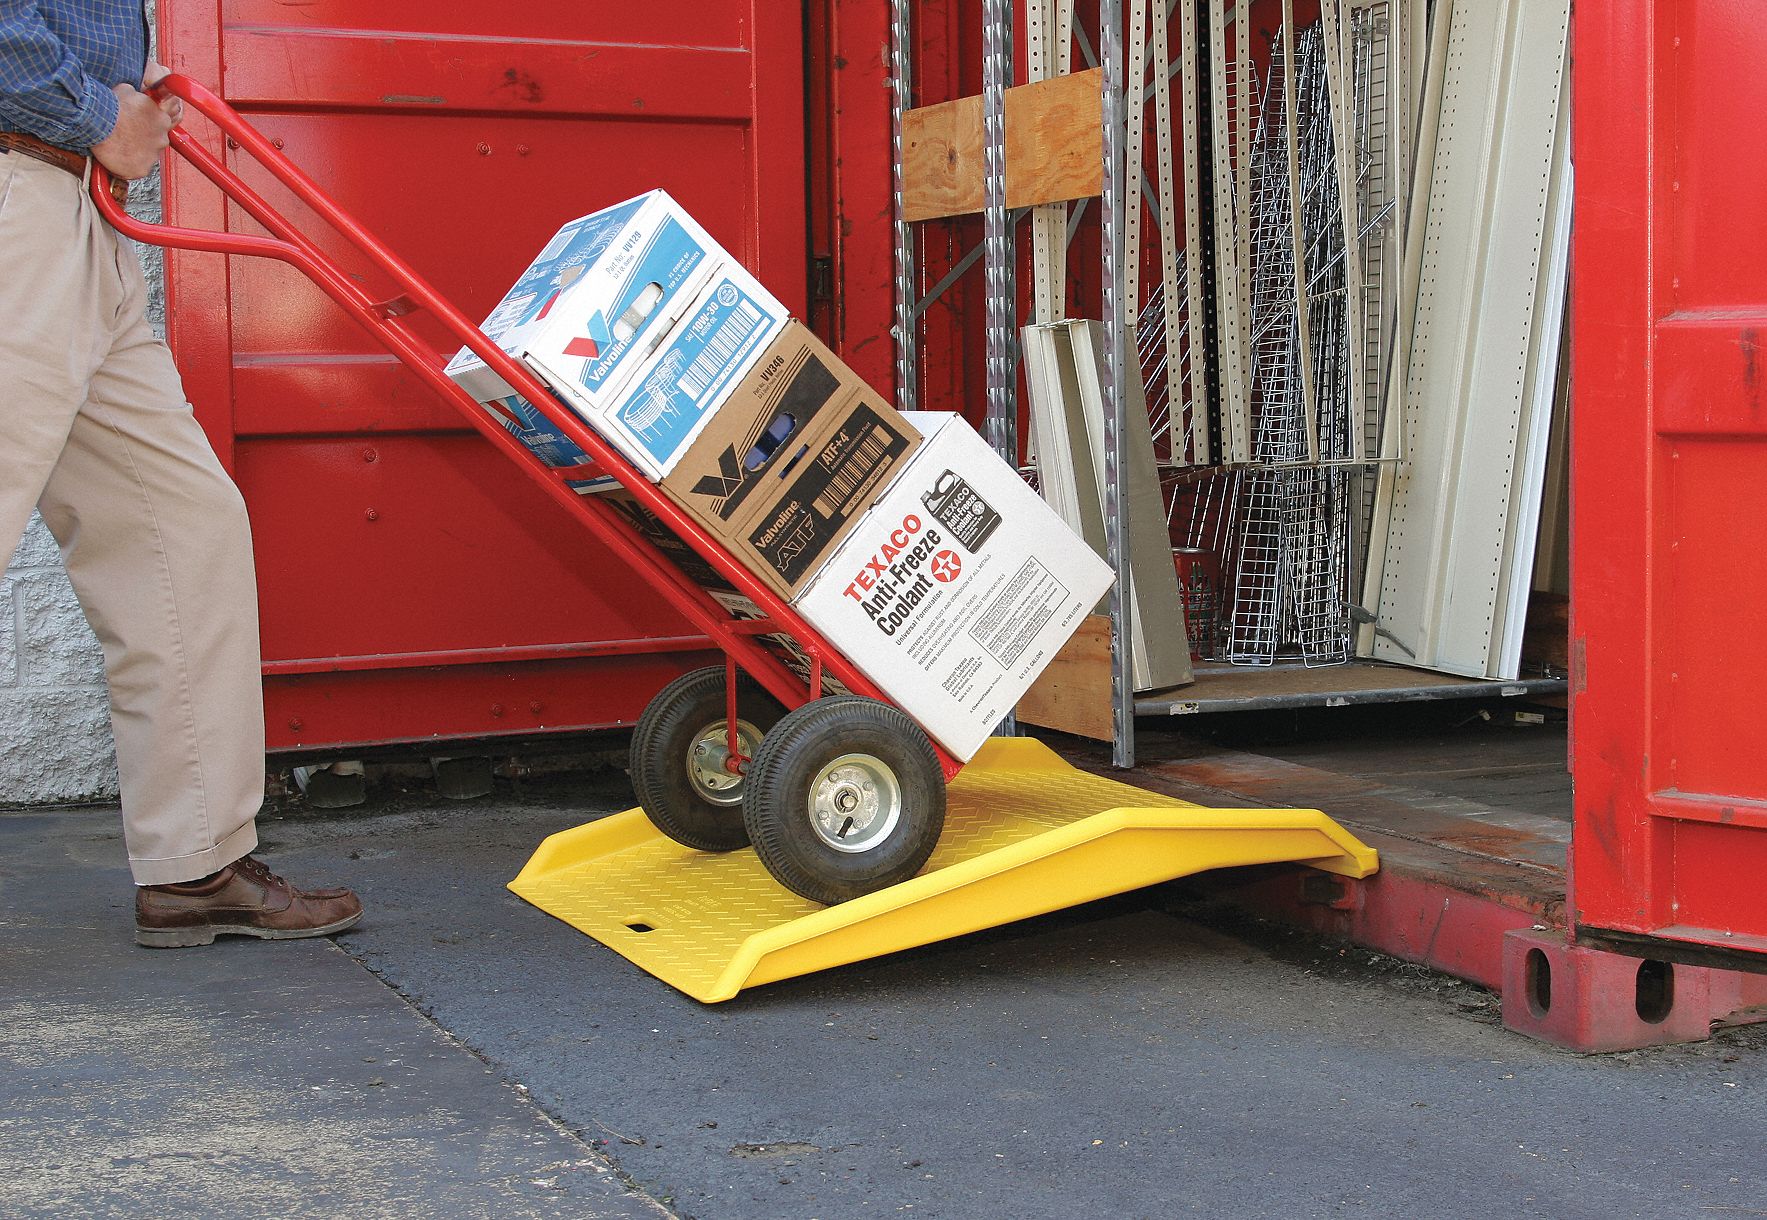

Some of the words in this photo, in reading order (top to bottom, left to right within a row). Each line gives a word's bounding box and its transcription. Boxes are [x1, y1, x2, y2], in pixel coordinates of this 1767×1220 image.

[605, 261, 617, 274] Part
[672, 257, 685, 272] CHOICE
[680, 250, 699, 273] MECHANICS
[684, 332, 694, 342] SAE
[692, 301, 718, 332] 10W-30
[699, 322, 712, 336] MOTOR
[709, 316, 717, 324] OIL
[760, 355, 784, 381] VV346
[939, 487, 969, 520] TEXACO
[946, 494, 976, 529] Anti-Freeze
[755, 501, 798, 547] Valvoline
[952, 510, 974, 535] Coolant
[777, 513, 814, 571] ATF
[843, 514, 920, 600] TEXACO
[862, 530, 940, 619] Anti-Freeze
[877, 573, 932, 635] Coolant
[895, 619, 917, 645] Universal
[915, 590, 942, 621] Formulation
[906, 635, 923, 655] PROTECTS
[922, 619, 936, 636] AGAINST
[934, 608, 944, 620] RUST
[943, 601, 951, 610] AND
[950, 580, 969, 602] CORROSION
[972, 568, 980, 576] ALL
[977, 553, 991, 569] METALS
[911, 638, 929, 659] INCLUDING
[928, 618, 945, 639] ALUMINUM
[917, 647, 933, 665] REDUCES
[931, 622, 953, 648] OVERHEATING
[952, 614, 960, 624] AND
[924, 656, 937, 671] OFFERS
[935, 637, 952, 656] MAXIMUM
[950, 615, 970, 638] PROTECTION
[972, 600, 983, 612] COLD
[981, 573, 1005, 601] TEMPERATURES
[941, 670, 956, 687] Chevron
[954, 657, 967, 671] Texaco
[945, 676, 957, 691] Global
[956, 656, 974, 677] Lubricants
[1029, 650, 1043, 666] GALLONS
[981, 708, 995, 725] BOTTLES
